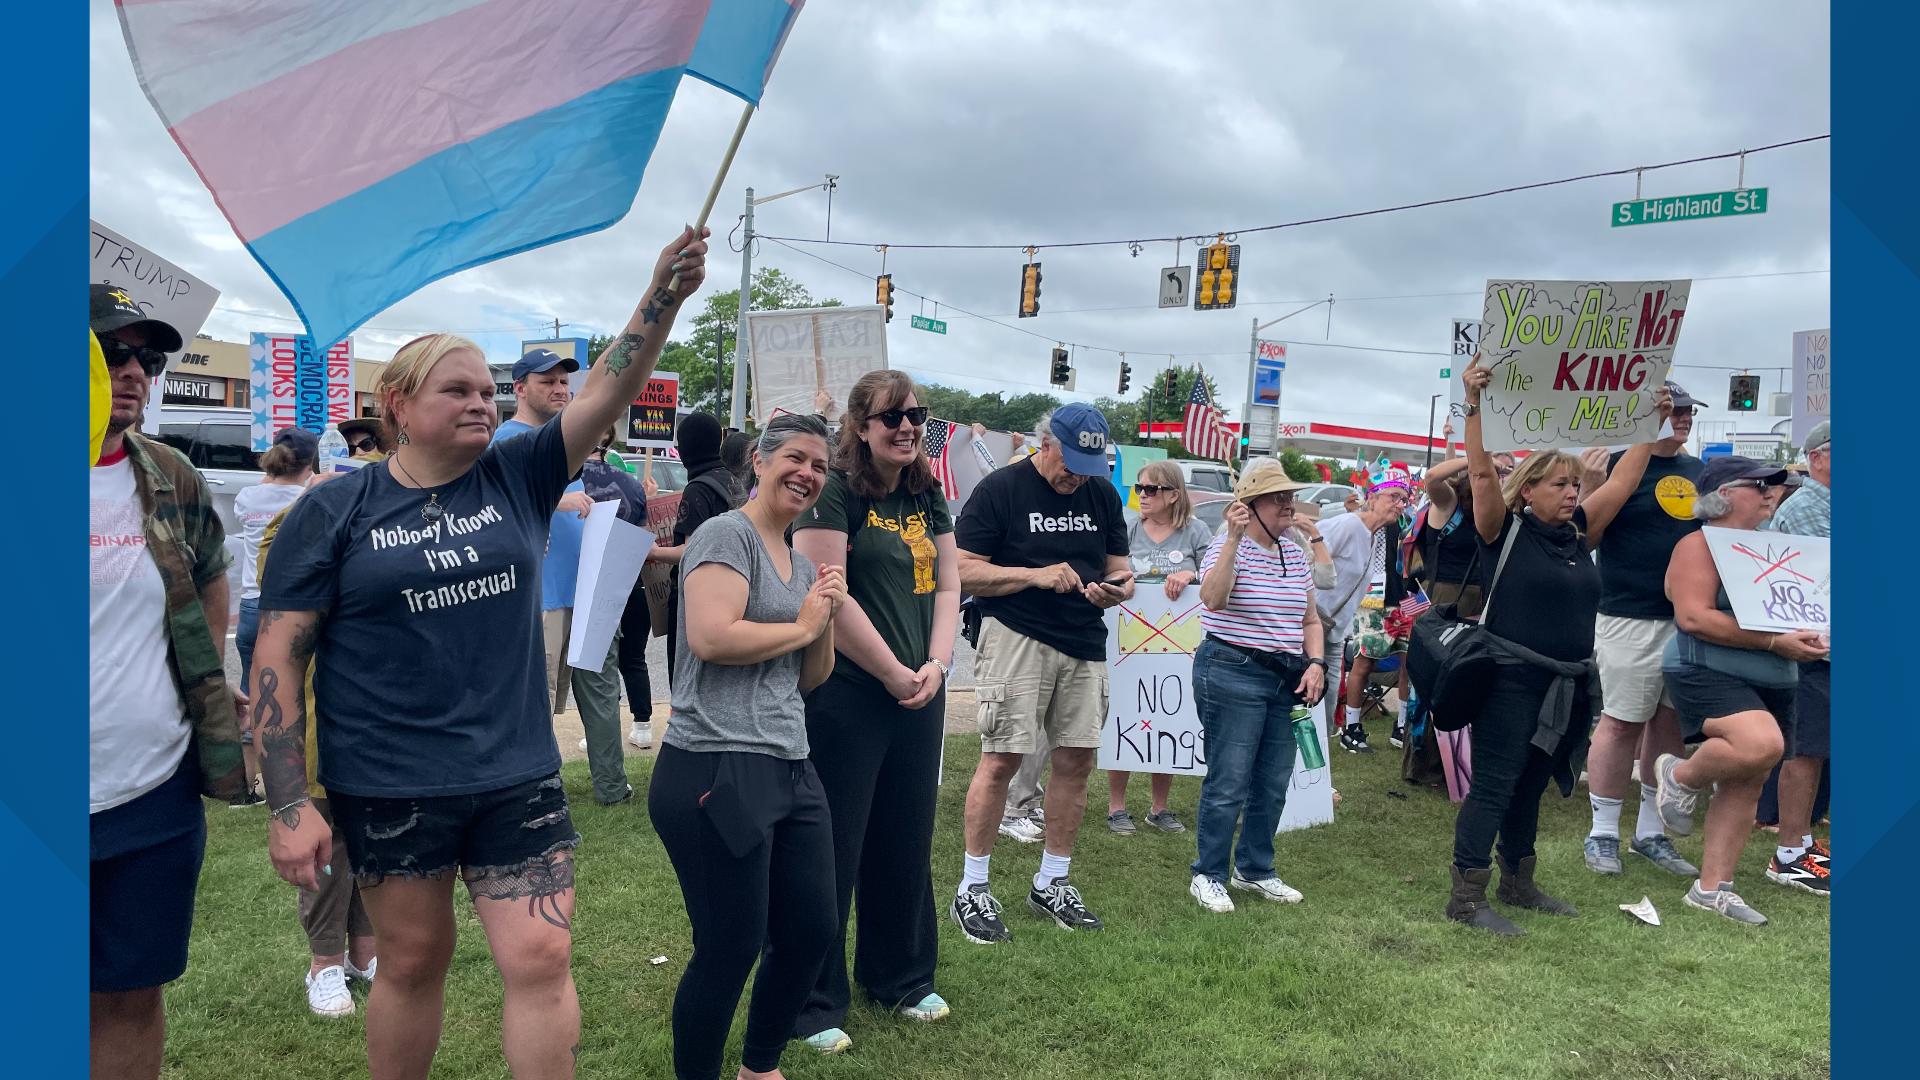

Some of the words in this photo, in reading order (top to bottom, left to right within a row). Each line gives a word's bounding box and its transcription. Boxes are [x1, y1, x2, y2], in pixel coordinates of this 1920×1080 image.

[1618, 203, 1634, 223] S.
[1642, 194, 1722, 221] Highland
[91, 231, 191, 302] TRUMP
[1163, 296, 1183, 305] ONLY
[912, 316, 930, 330] Poplar
[271, 337, 298, 398] LOOKS
[1504, 358, 1533, 392] The
[1552, 351, 1648, 392] KING
[164, 380, 209, 397] NMENT
[326, 382, 350, 399] IS
[1078, 430, 1106, 449] 901
[1028, 510, 1098, 533] Resist.
[371, 520, 441, 550] Nobody
[423, 549, 462, 572] I'm
[463, 545, 479, 563] a
[401, 564, 517, 613] Transsexual
[1770, 585, 1805, 606] NO
[1762, 599, 1827, 623] KINGS
[1138, 674, 1182, 716] NO
